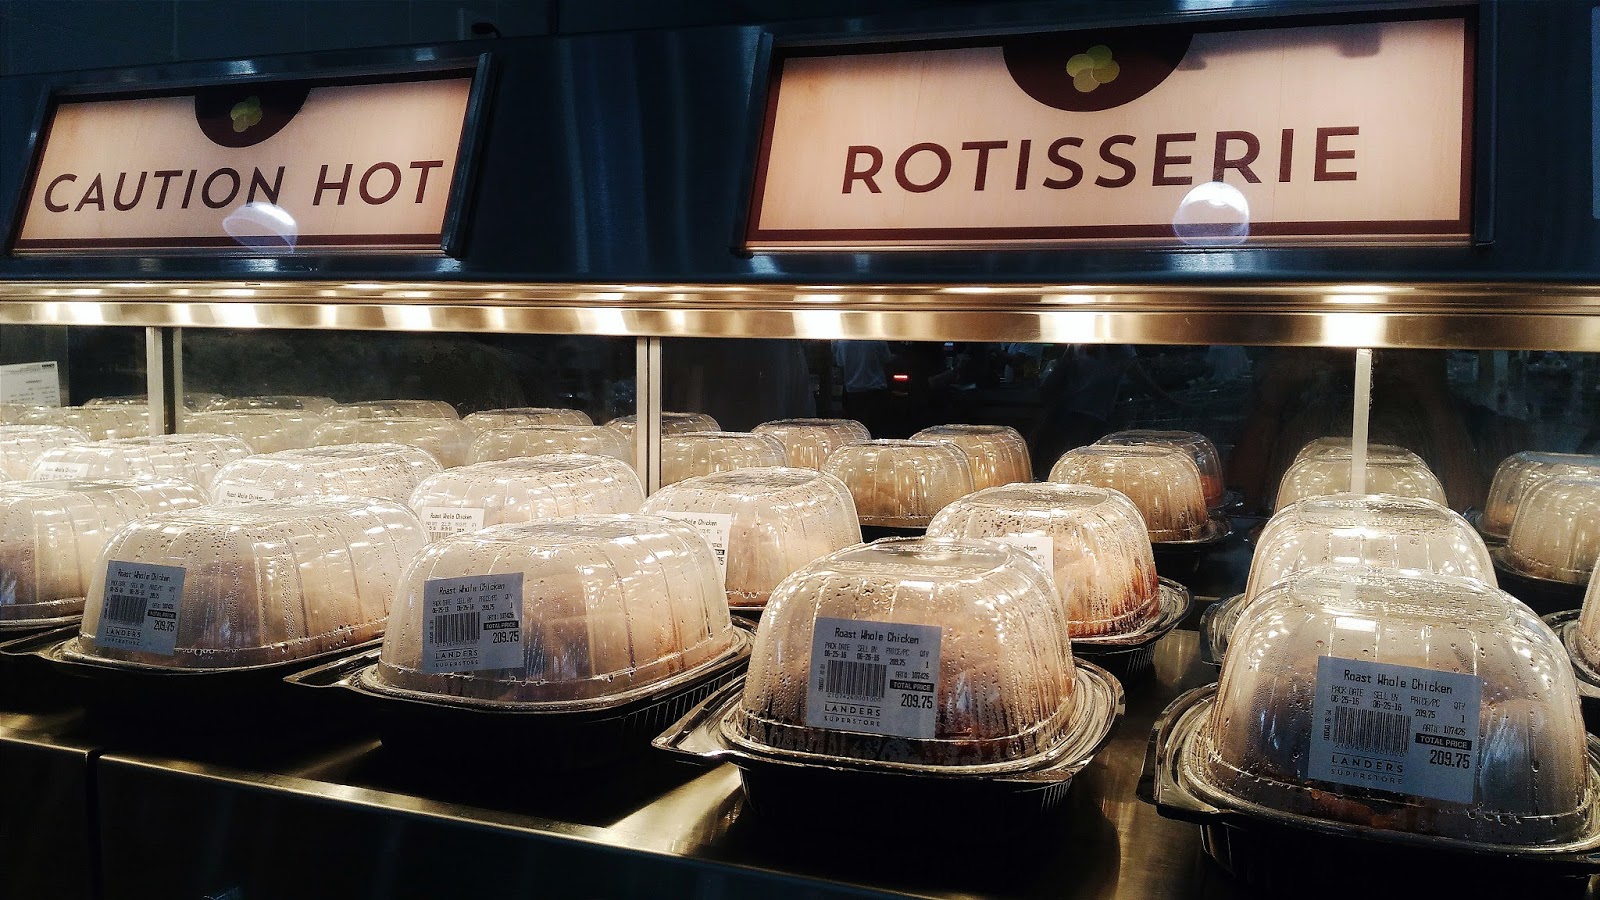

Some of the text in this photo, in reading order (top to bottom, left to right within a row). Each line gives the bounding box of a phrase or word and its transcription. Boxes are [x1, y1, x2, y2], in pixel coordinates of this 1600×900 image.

[841, 126, 1360, 194] ROTISSERIE
[44, 160, 444, 213] CAUTION HOT
[106, 628, 140, 637] LANDERS
[154, 620, 175, 632] 209.75
[493, 631, 519, 644] 209.75
[835, 627, 919, 644] Roast Whole Chicken
[435, 650, 478, 659] LANDERS
[893, 681, 931, 691] TOTAL PRICE
[1344, 669, 1452, 694] Roast Whole Chicken
[901, 694, 933, 709] 209.75
[825, 704, 880, 716] LANDERS
[1415, 709, 1436, 719] 209.75
[1461, 715, 1465, 723] 1
[824, 715, 880, 727] SUPERSTORE
[1420, 735, 1468, 749] TOTAL PRICE
[1332, 755, 1403, 773] LANDERS
[1430, 750, 1470, 769] 209.75
[1331, 768, 1402, 785] SUPERSTORE
